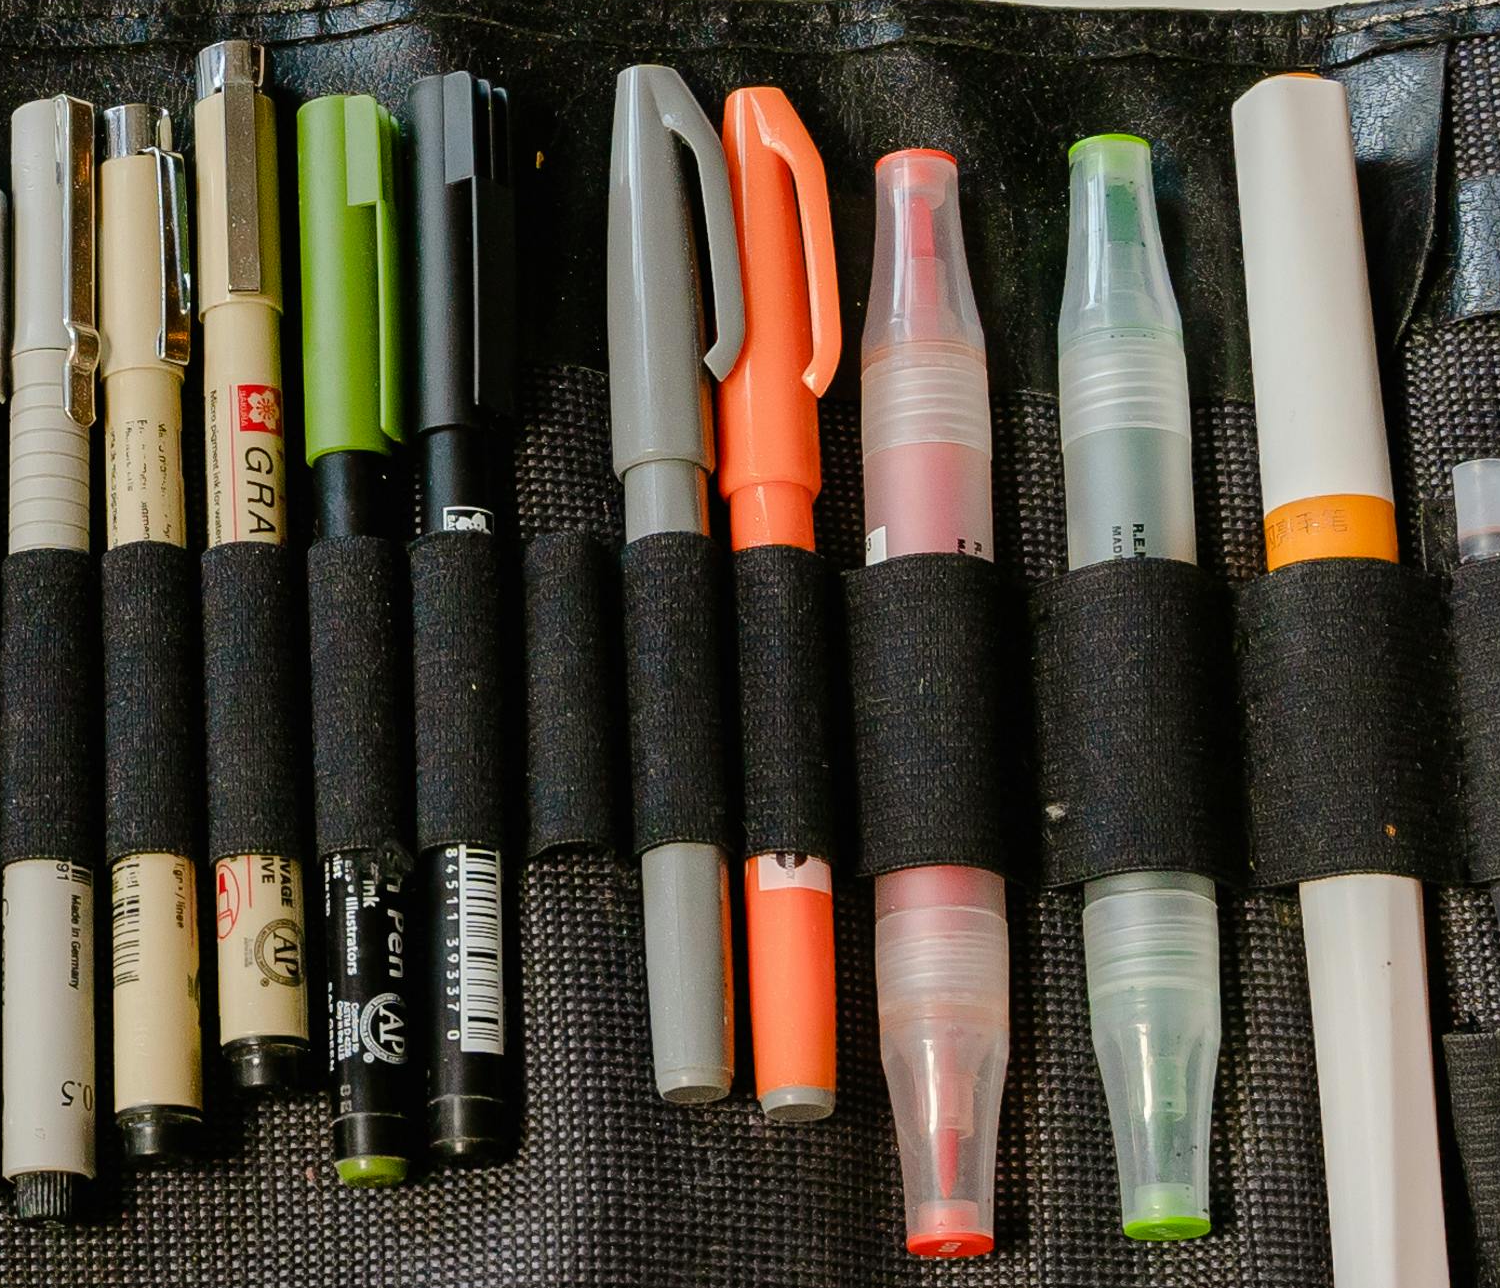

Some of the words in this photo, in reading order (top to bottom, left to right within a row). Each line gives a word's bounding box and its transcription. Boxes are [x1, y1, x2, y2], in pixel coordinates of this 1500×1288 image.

[209, 390, 218, 422] Micro
[210, 424, 219, 470] pigment
[213, 472, 221, 489] ink
[214, 490, 222, 506] for
[445, 847, 459, 921] 84511
[70, 894, 82, 924] Made
[71, 927, 81, 937] in
[273, 933, 300, 976] AP
[345, 896, 359, 976] Illustrators
[387, 908, 405, 978] Pen
[68, 940, 82, 990] Germany
[445, 937, 460, 1012] 39337
[379, 1006, 406, 1055] AP
